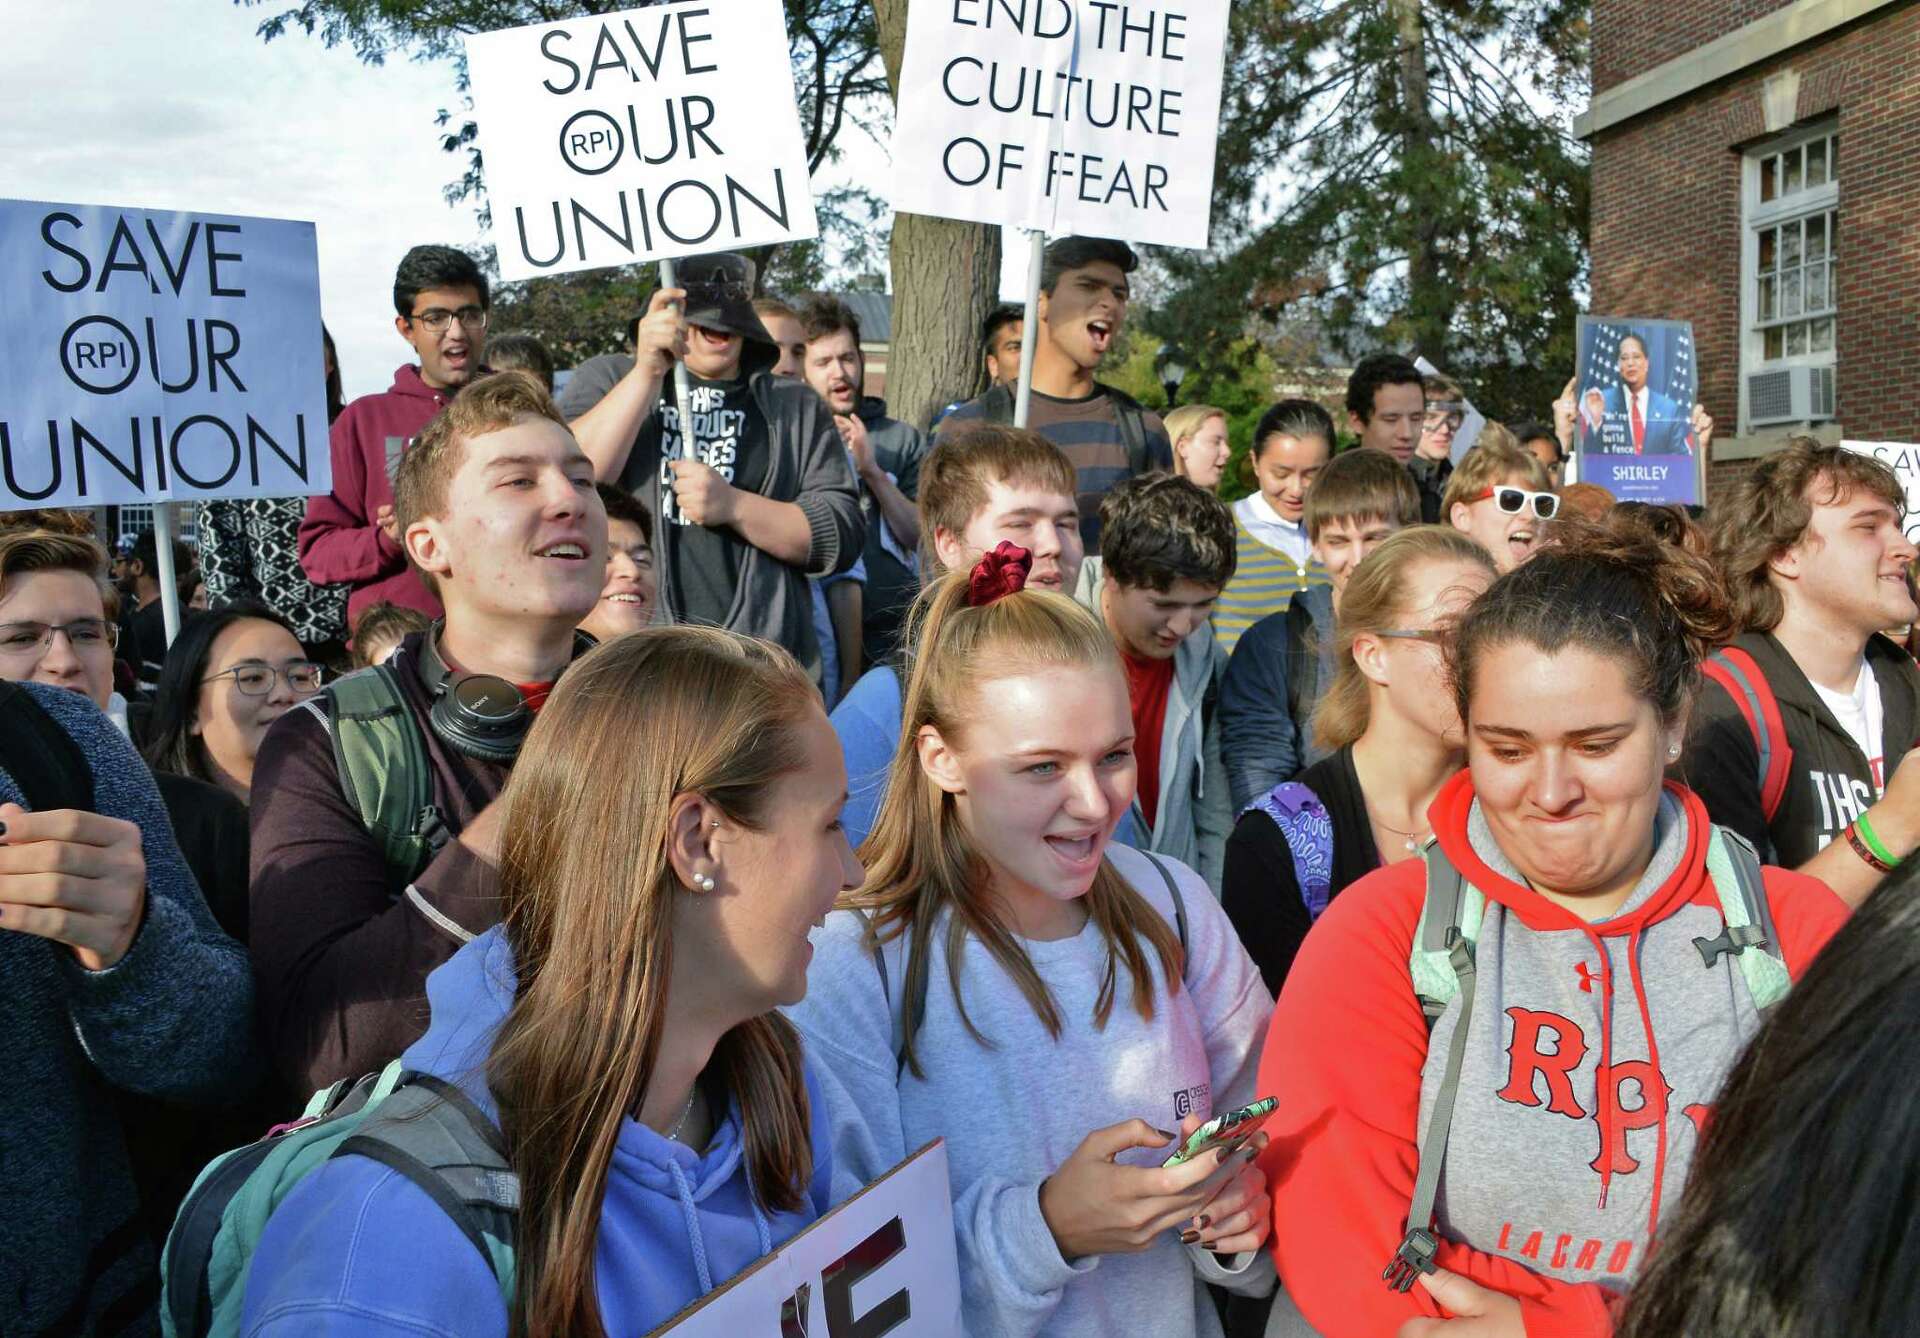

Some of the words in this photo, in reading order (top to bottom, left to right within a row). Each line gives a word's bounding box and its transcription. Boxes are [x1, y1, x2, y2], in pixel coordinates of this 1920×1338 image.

[540, 9, 718, 95] SAVE
[953, 0, 1072, 38] END
[1089, 1, 1187, 61] THE
[943, 56, 1183, 137] CULTURE
[559, 95, 725, 175] OUR
[571, 130, 613, 156] RPI
[943, 137, 1025, 190] OF
[1045, 150, 1168, 212] FEAR
[515, 168, 790, 268] UNION
[40, 211, 247, 298] SAVE
[60, 315, 248, 396] OUR
[75, 342, 127, 368] RPI
[660, 403, 745, 437] RDUCT
[689, 387, 725, 413] HIS
[0, 413, 309, 500] UNION
[661, 432, 737, 467] CASES
[1612, 465, 1668, 481] SHIRLEY
[1498, 1223, 1640, 1273] LACRO
